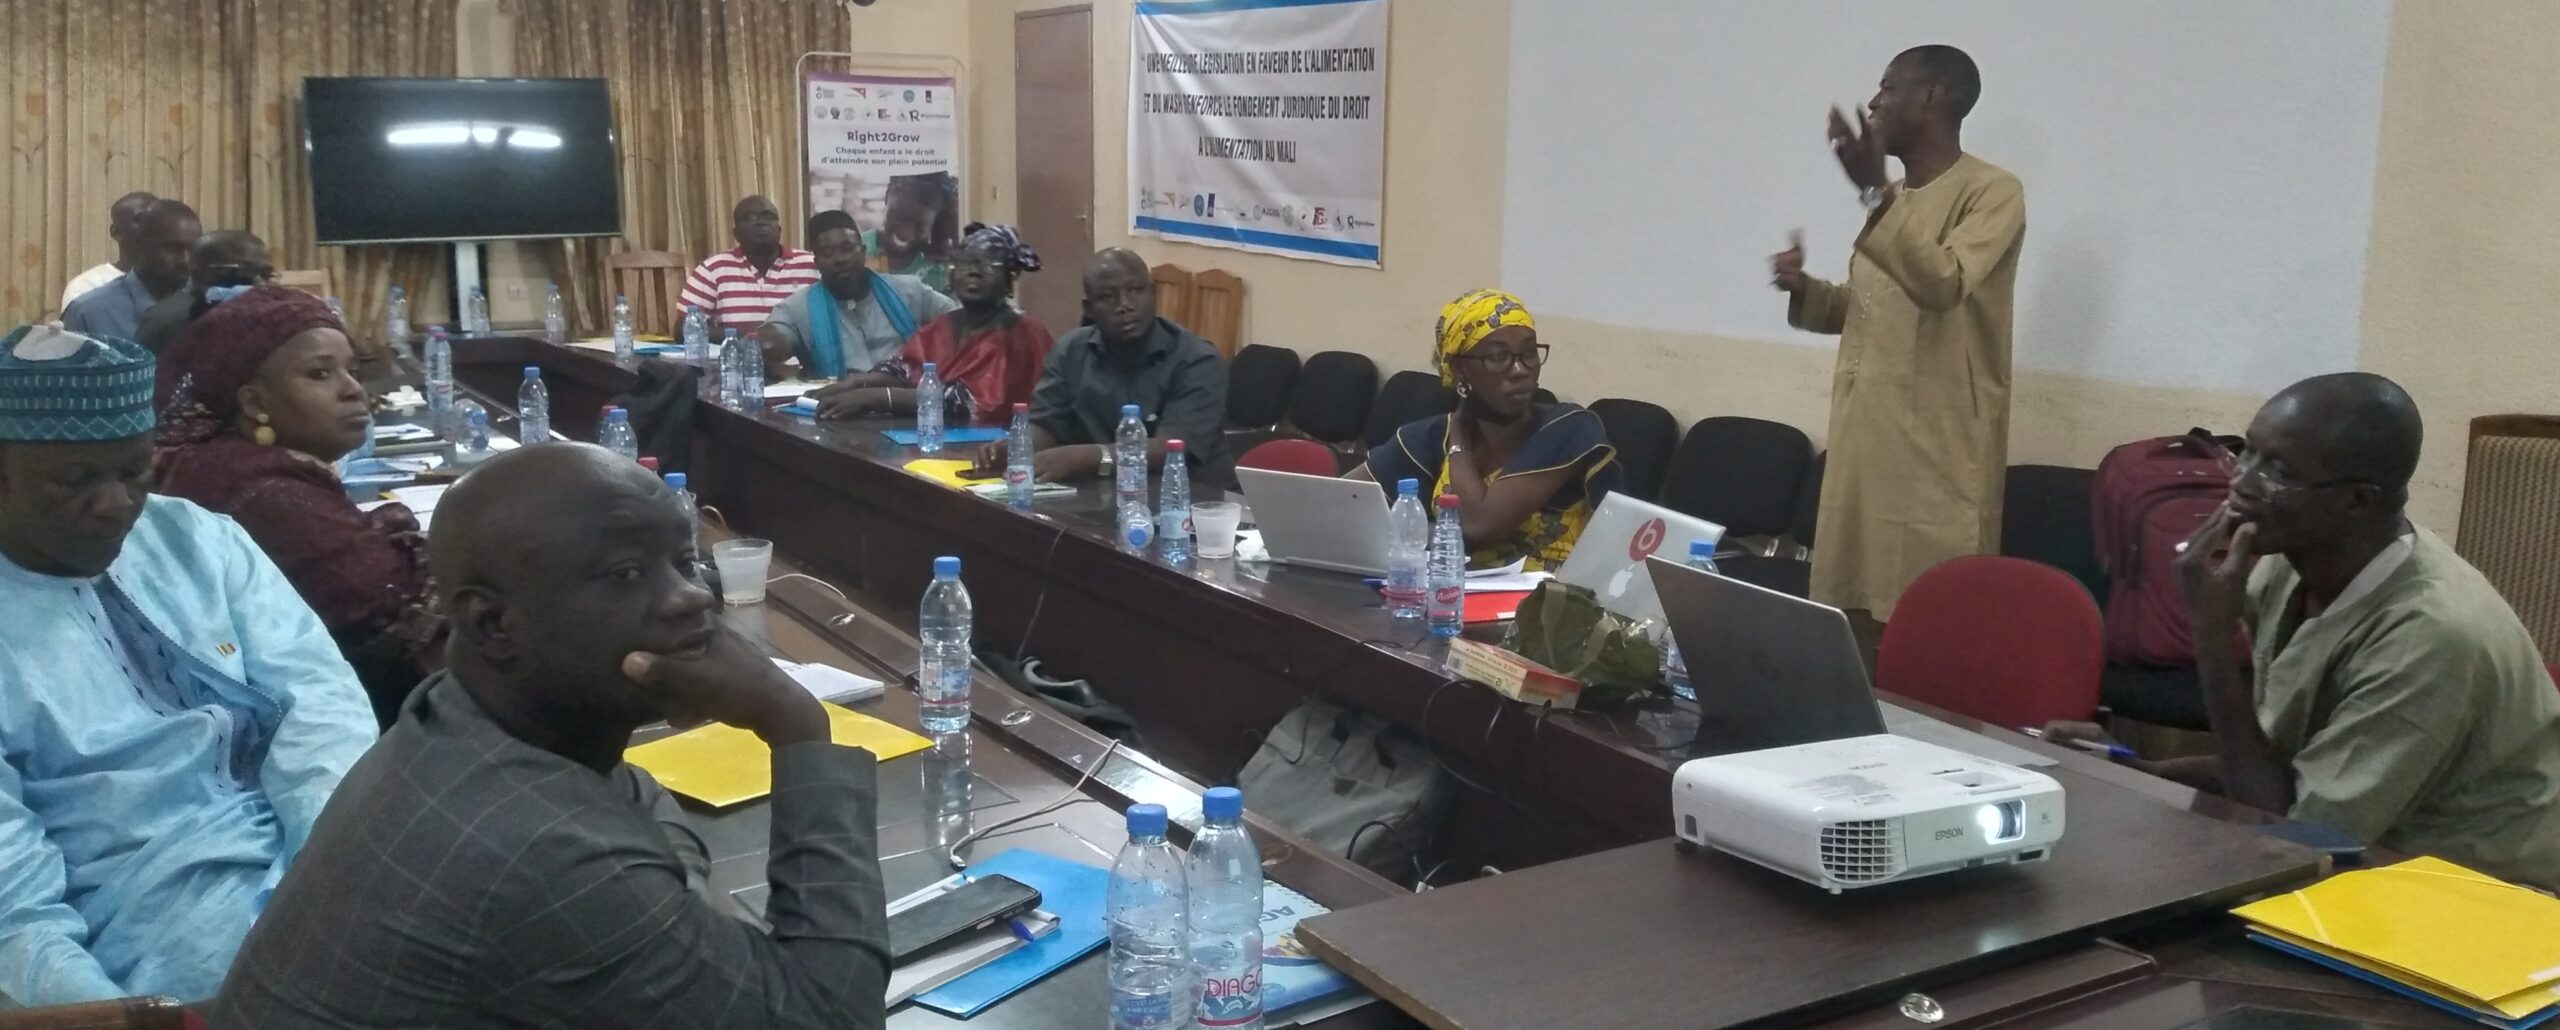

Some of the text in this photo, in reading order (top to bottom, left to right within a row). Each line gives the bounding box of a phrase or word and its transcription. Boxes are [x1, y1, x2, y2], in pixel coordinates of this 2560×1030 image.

[1147, 52, 1160, 73] UNE
[1246, 51, 1257, 74] EN
[1259, 51, 1290, 74] FAVEUR
[1291, 50, 1302, 73] DE
[1304, 47, 1375, 73] L'ALIMENTATION
[1223, 95, 1232, 117] LE
[1233, 95, 1280, 118] FONDEMENT
[1281, 95, 1326, 121] JURIDIQUE
[1328, 95, 1340, 119] DU
[1342, 95, 1371, 120] DROIT
[847, 129, 920, 145] Right2Grow
[835, 146, 867, 155] Chaque
[869, 147, 895, 155] enfant
[1265, 139, 1275, 162] AU
[1276, 140, 1296, 163] MALI
[888, 158, 909, 166] plein
[911, 158, 948, 166] potentiel
[1935, 826, 1964, 841] EPSON
